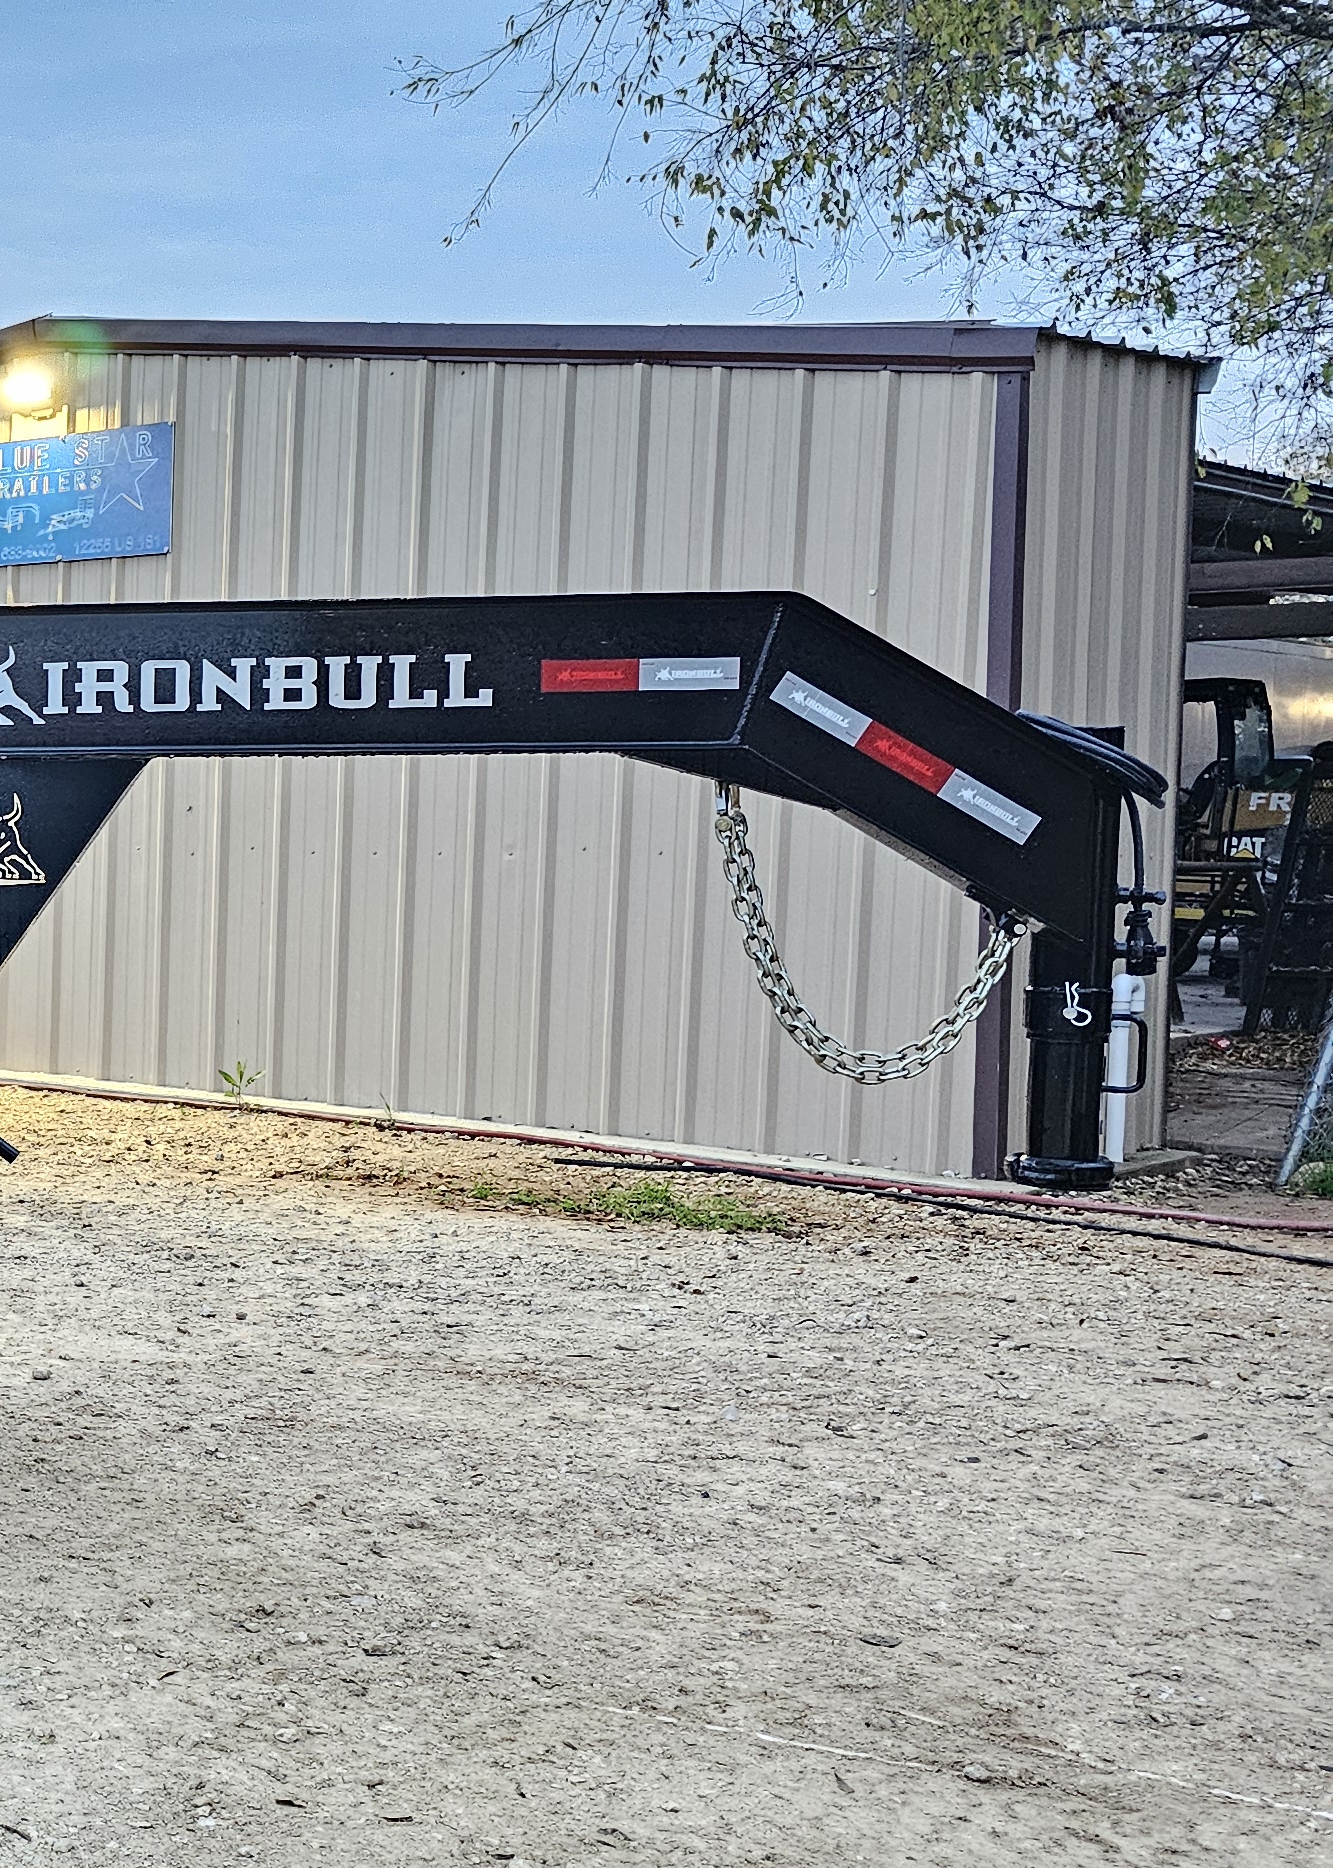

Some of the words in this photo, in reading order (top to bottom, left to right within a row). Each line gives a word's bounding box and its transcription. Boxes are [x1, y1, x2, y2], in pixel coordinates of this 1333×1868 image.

[74, 430, 153, 466] STAR
[42, 653, 493, 715] IRONBULL
[1223, 836, 1266, 858] CAT
